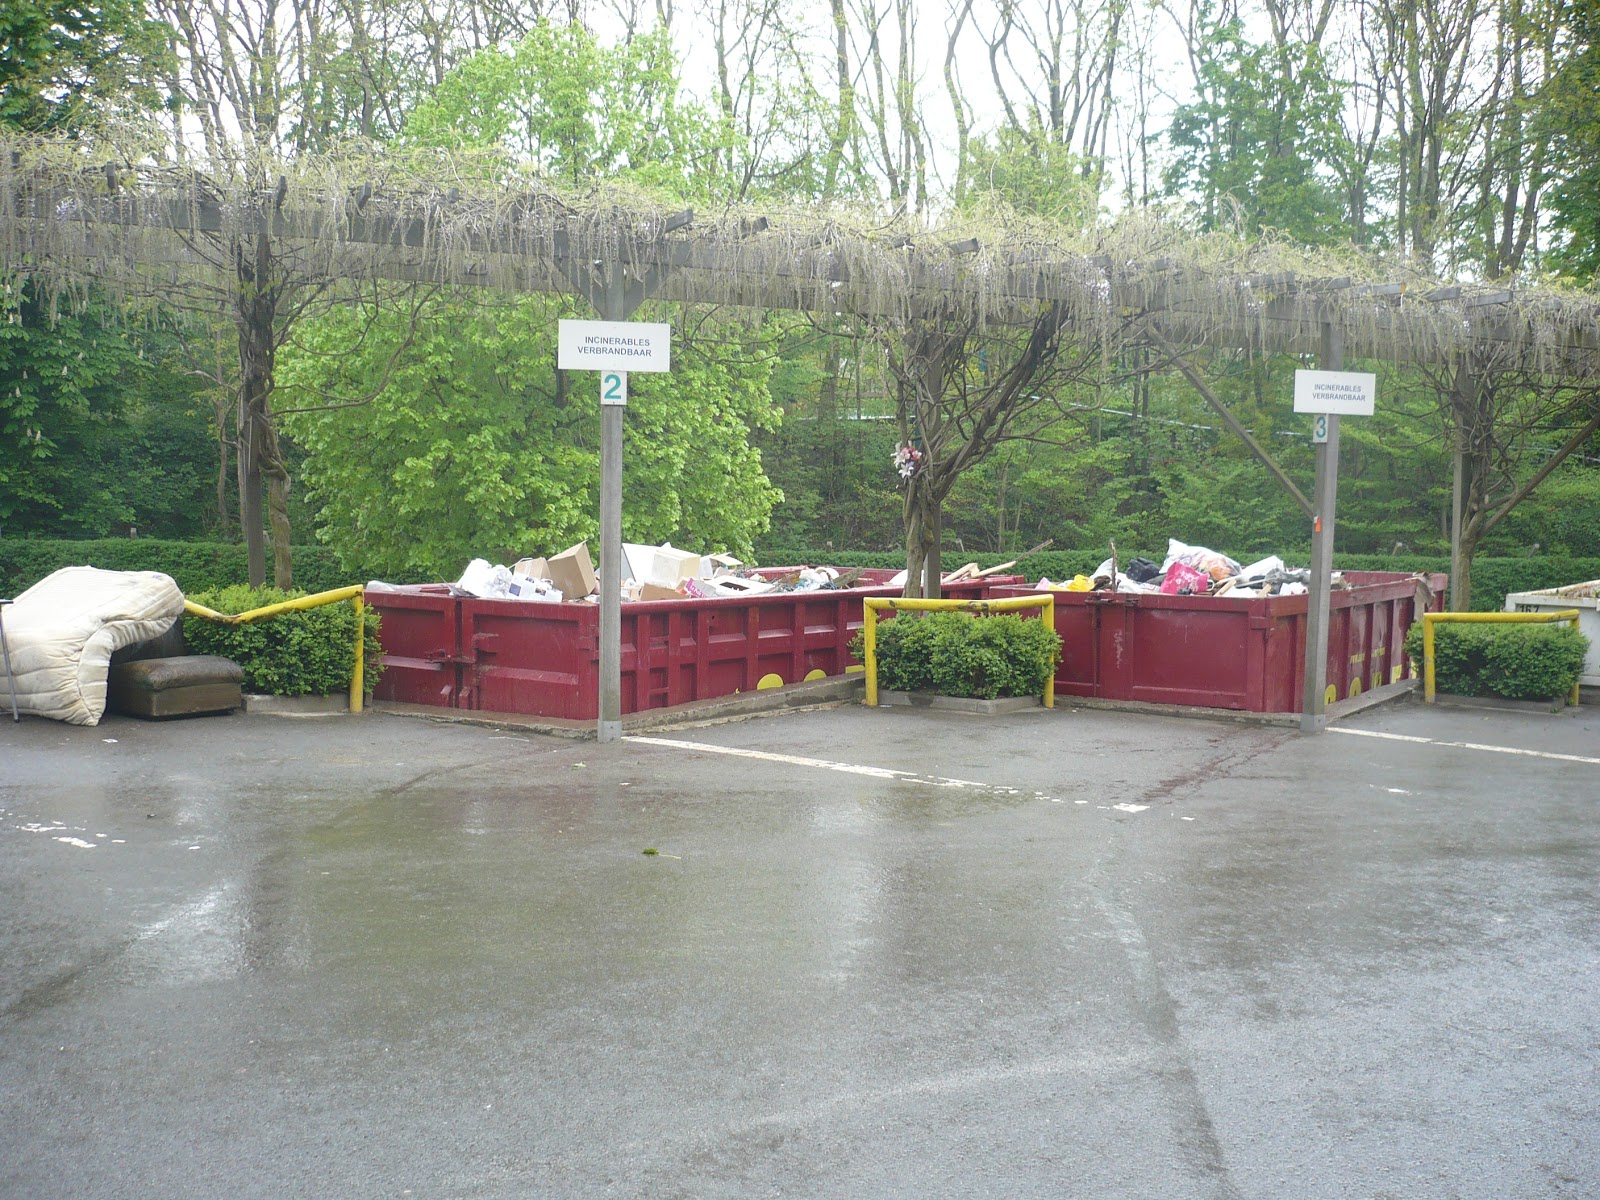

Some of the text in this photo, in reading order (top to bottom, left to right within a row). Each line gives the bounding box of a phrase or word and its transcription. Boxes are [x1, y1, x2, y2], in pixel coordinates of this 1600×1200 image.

[585, 336, 650, 346] INCINERABLES
[577, 346, 652, 357] VERBRANDBAAR
[604, 374, 622, 400] 2
[1314, 383, 1362, 392] INCINERABLES
[1312, 392, 1366, 402] VERBRANDBAAR
[1316, 416, 1327, 439] 3
